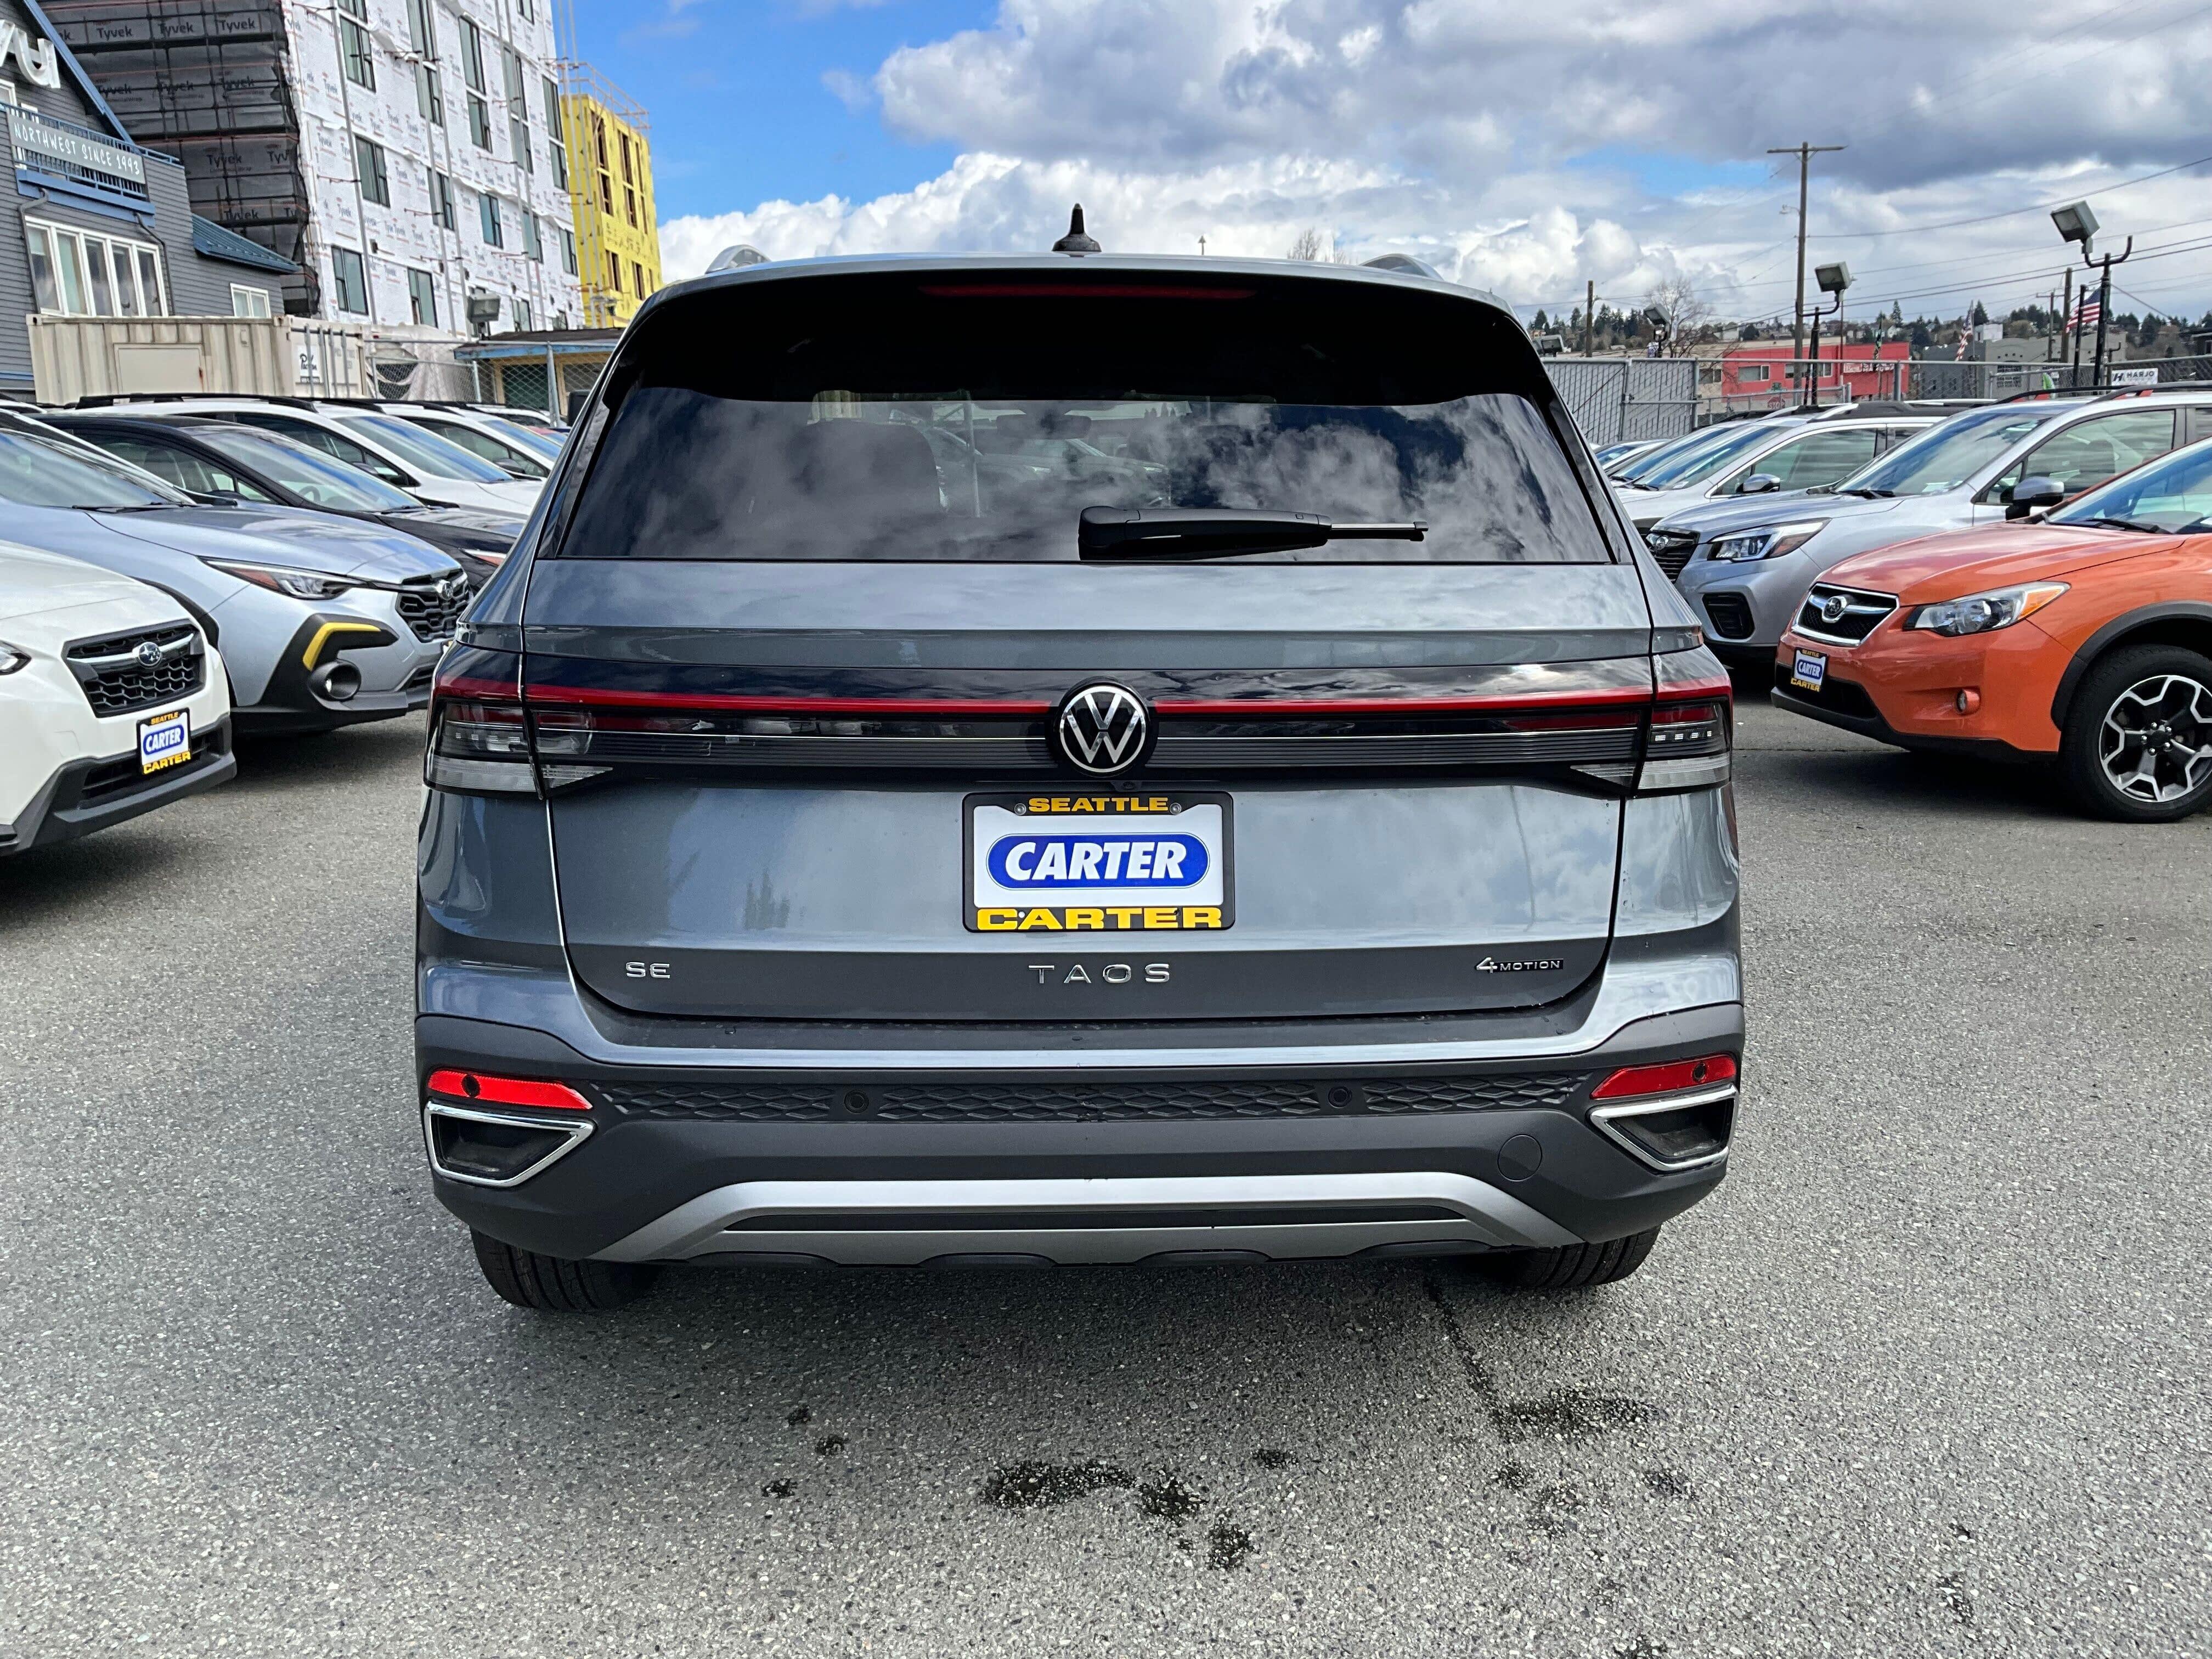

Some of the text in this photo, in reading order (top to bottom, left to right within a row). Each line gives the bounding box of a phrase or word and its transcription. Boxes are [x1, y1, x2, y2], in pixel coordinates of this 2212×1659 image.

[97, 25, 133, 42] Tyvek
[219, 18, 255, 32] Tyvek
[14, 122, 140, 175] NORTHWEST SINCE 1993
[1802, 648, 1820, 658] SEATTLE
[1798, 661, 1821, 678] CARTER
[1791, 677, 1820, 692] CARTER
[151, 712, 179, 725] SEATTLE
[145, 727, 181, 752] CARTER
[143, 751, 191, 775] CARTER
[1028, 797, 1169, 812] SEATTLE
[1005, 841, 1187, 881] CARTER
[977, 907, 1222, 930] CARTER
[625, 961, 670, 979] SE
[1028, 963, 1170, 984] TAOS
[1475, 956, 1561, 974] 4MOTION
